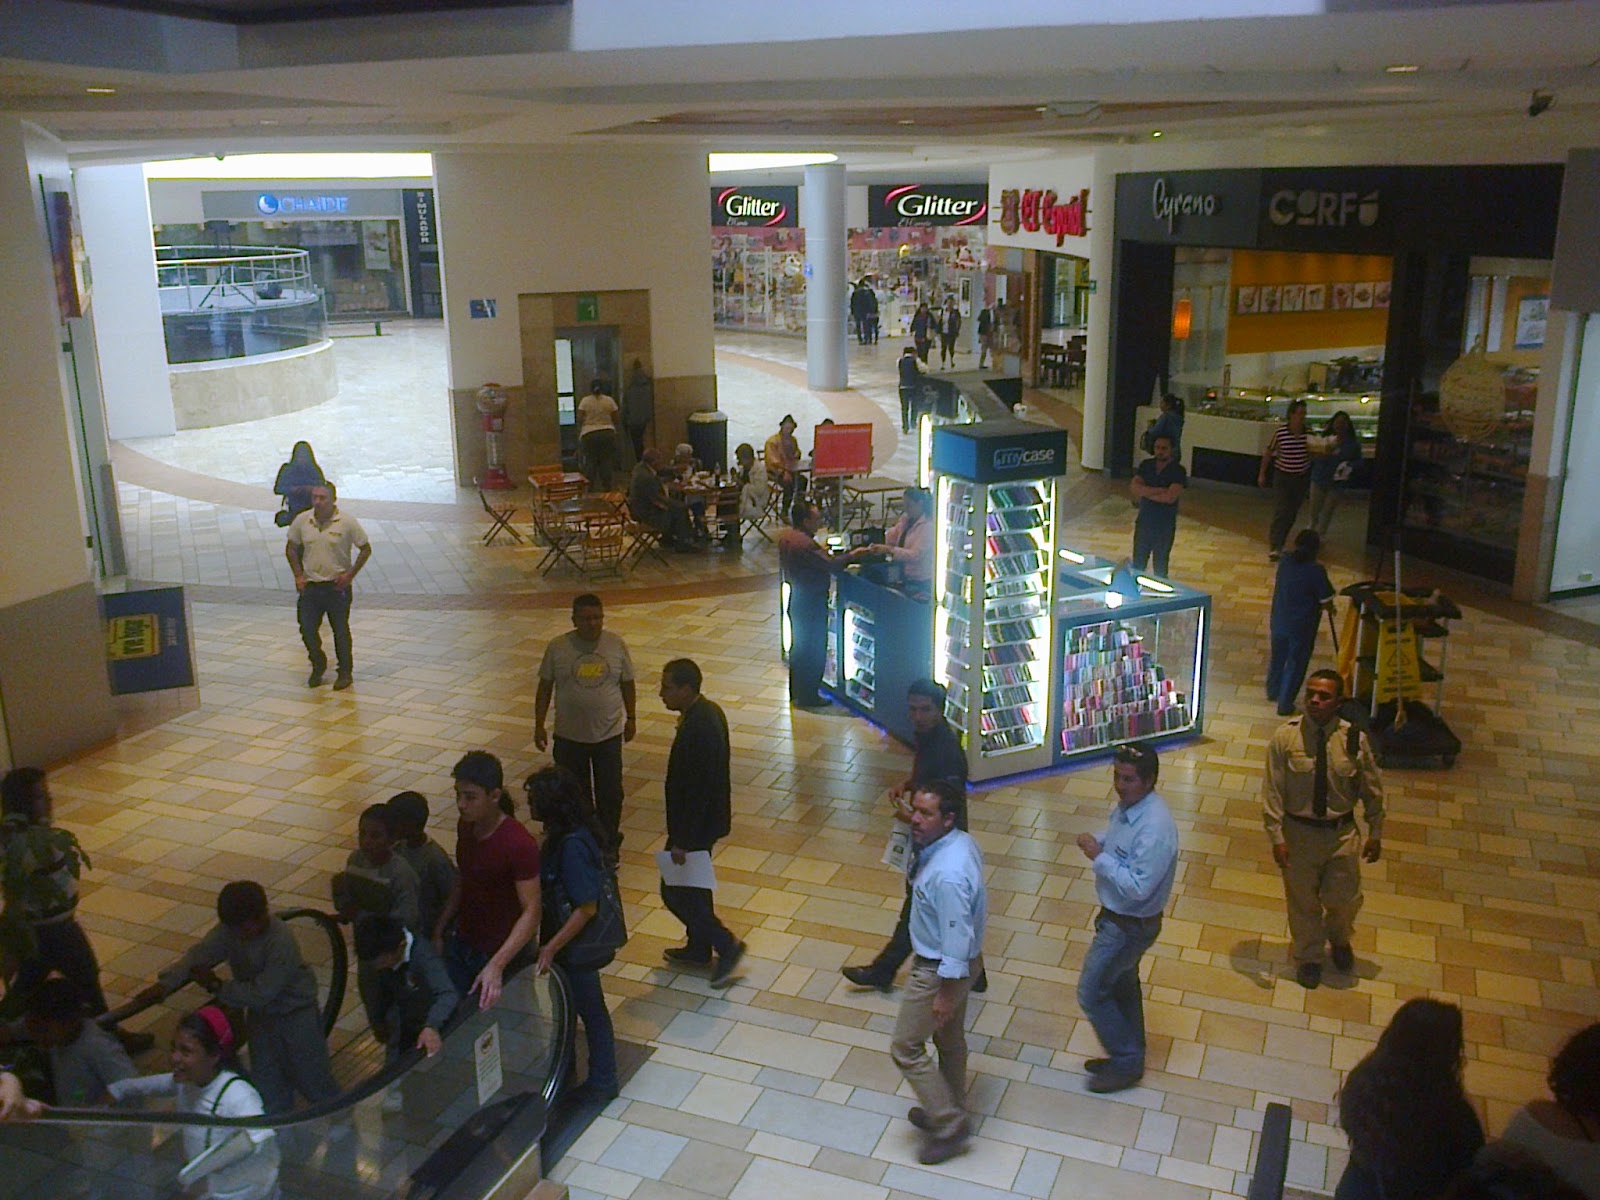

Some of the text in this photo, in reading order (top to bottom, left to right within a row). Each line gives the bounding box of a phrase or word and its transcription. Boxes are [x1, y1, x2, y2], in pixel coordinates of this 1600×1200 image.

[278, 195, 349, 213] CHAIDE
[726, 194, 780, 217] Glitter
[897, 194, 979, 217] Glitter
[1152, 178, 1216, 235] Cyrano
